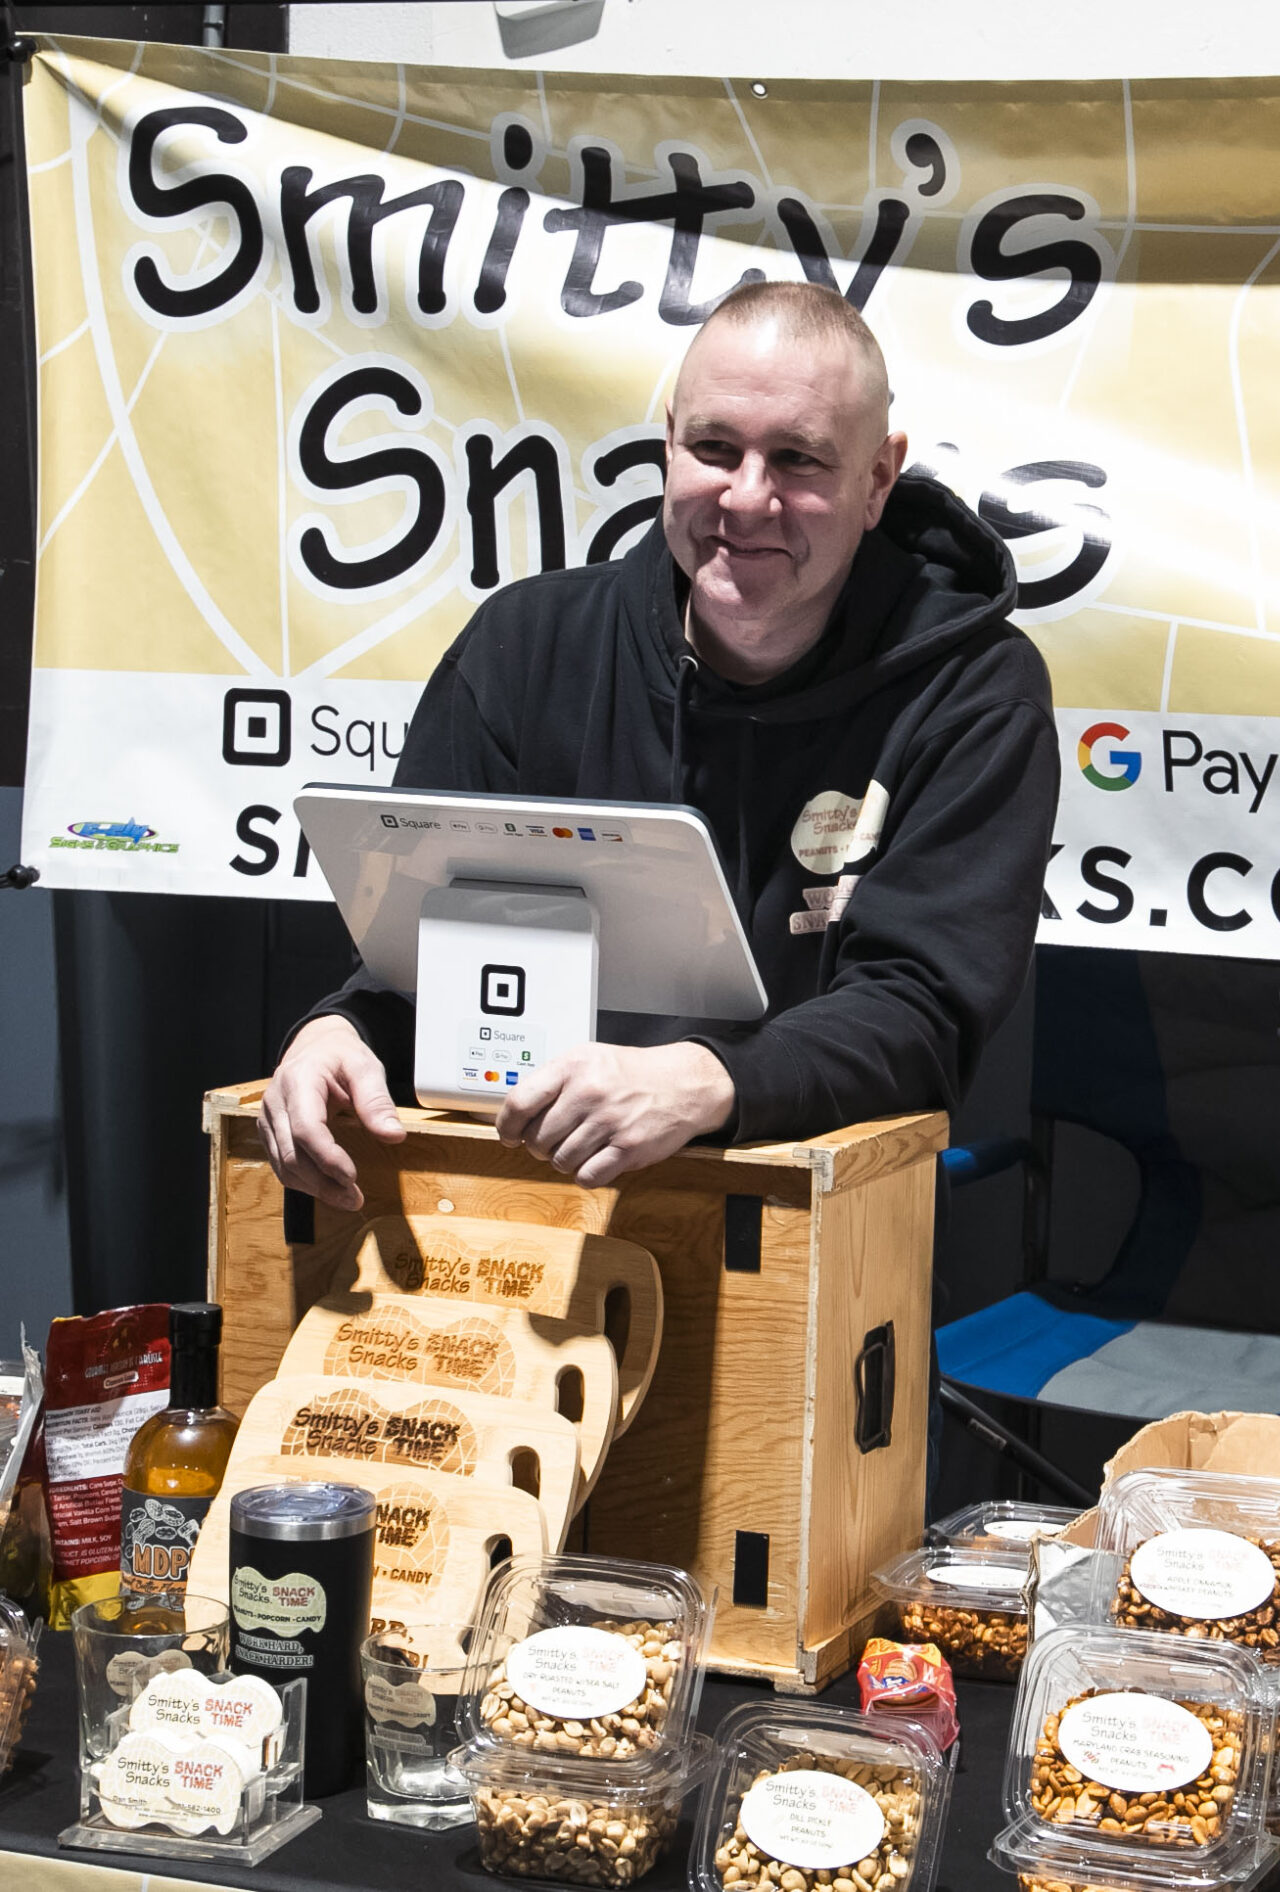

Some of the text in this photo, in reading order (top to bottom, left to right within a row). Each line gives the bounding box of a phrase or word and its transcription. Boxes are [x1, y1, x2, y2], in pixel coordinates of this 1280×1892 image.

[129, 106, 1102, 346] Smitty's
[1162, 729, 1279, 814] Pay
[802, 806, 858, 823] Smitty's
[400, 817, 442, 831] Square
[494, 1030, 526, 1042] Square
[395, 1252, 546, 1284] Smitty's SNACK
[405, 1272, 533, 1299] Snacks TIME
[337, 1322, 499, 1363] Smitty's SNACK
[348, 1345, 418, 1371] Snacks
[294, 1407, 461, 1446] Smitty's SNACK
[306, 1429, 448, 1462] Snacks TIME
[1157, 1545, 1204, 1561] Smitty's
[1163, 1558, 1205, 1571] Snacks
[389, 1568, 433, 1585] CANDY
[234, 1574, 316, 1598] Smitty's SNACK
[278, 1597, 309, 1607] TIME
[257, 1613, 291, 1622] POPCORN
[263, 1655, 314, 1667] HARDER!
[535, 1657, 577, 1672] Snacks
[552, 1686, 587, 1697] PEANUTS
[148, 1694, 253, 1715] Smitty's SNACK
[156, 1709, 244, 1728] Snacks TIME
[1082, 1711, 1137, 1730] Smitty's
[1091, 1726, 1138, 1742] Snacks
[1072, 1739, 1191, 1764] MARYLAND CRAB SEASONING
[117, 1756, 223, 1777] Smitty's SNACK
[1110, 1757, 1149, 1770] PEANUTS
[125, 1772, 214, 1791] Snacks TIME
[765, 1780, 817, 1799] Smitty's
[772, 1794, 817, 1811] Snacks
[790, 1812, 832, 1827] DILL PICKLE
[791, 1825, 827, 1839] PEANUTS
